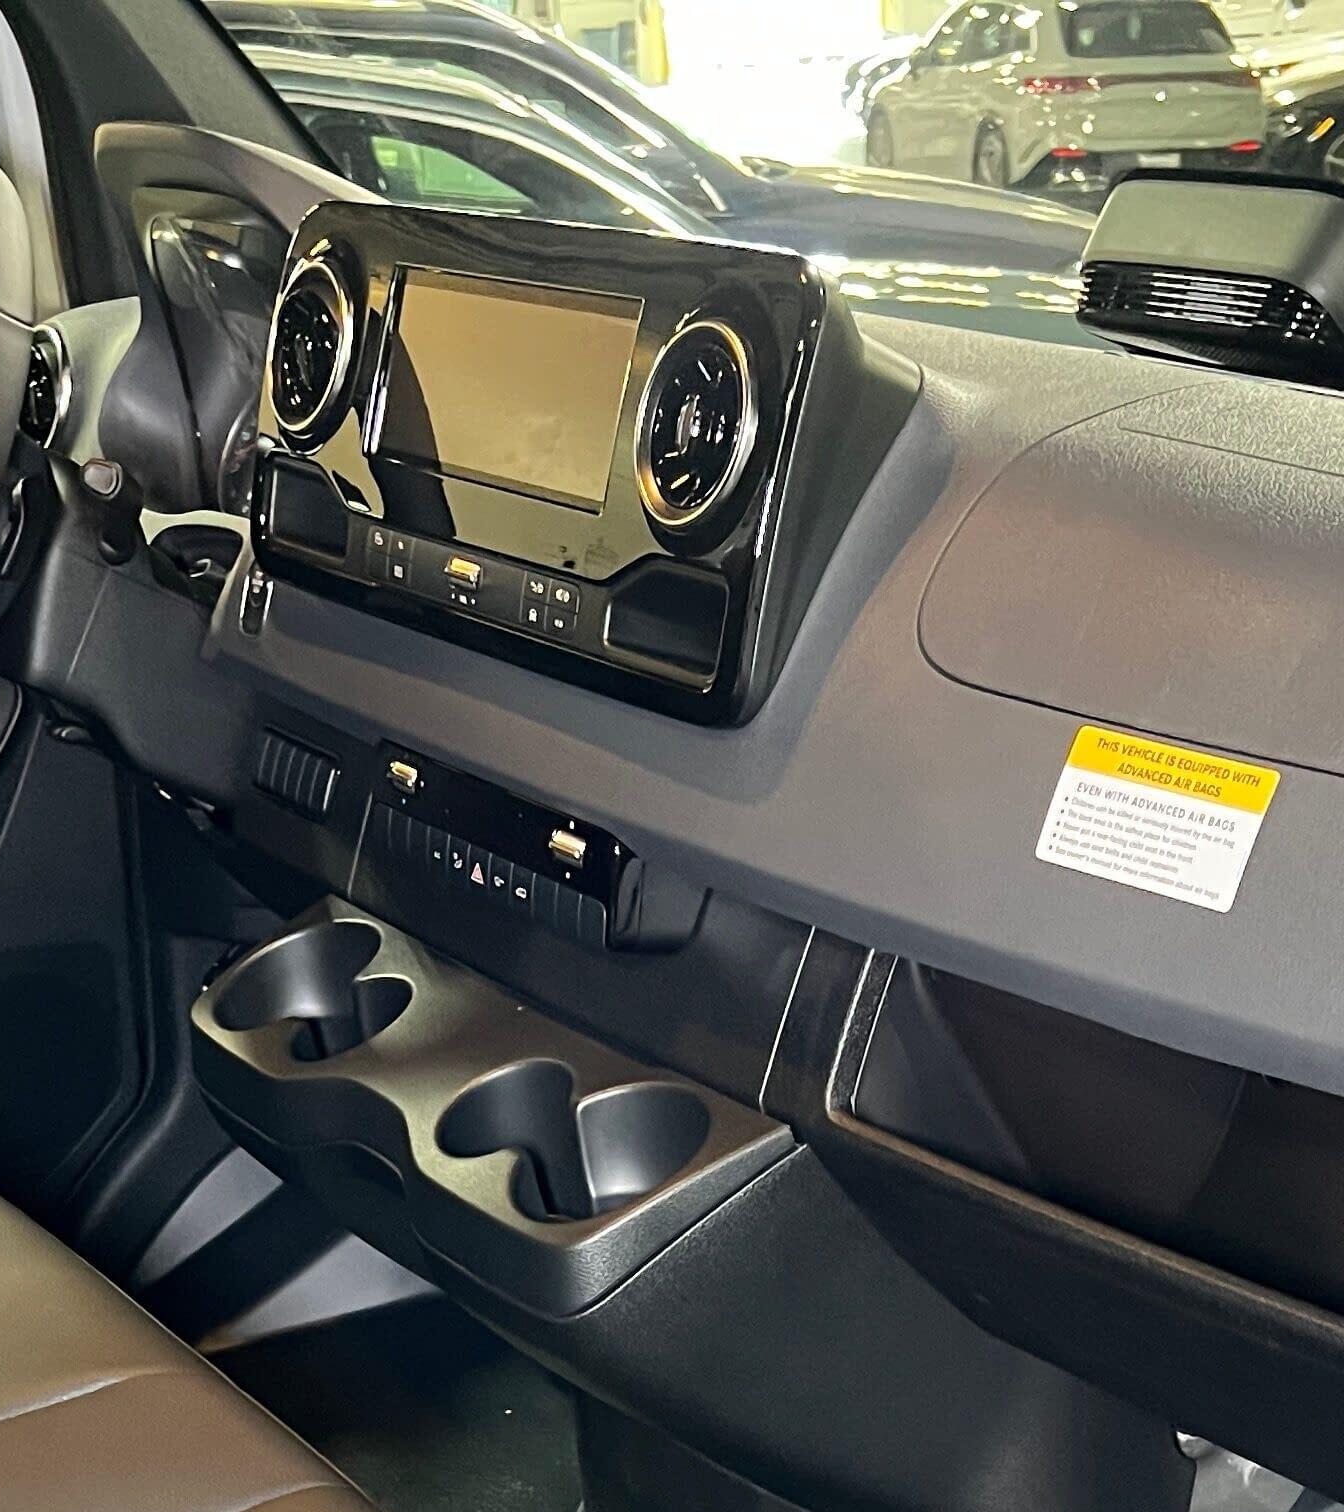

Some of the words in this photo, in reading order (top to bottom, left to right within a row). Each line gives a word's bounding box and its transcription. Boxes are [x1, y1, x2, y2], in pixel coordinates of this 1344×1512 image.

[1097, 737, 1119, 753] THIS
[1122, 745, 1164, 763] VEHICLE
[1165, 755, 1177, 767] IS
[1177, 758, 1231, 779] EQUIPPED
[1232, 771, 1261, 788] WITH
[1117, 762, 1173, 785] ADVANCED
[1173, 775, 1193, 791] AIR
[1193, 781, 1223, 798] BAGS
[1076, 781, 1102, 797] EVEN
[1104, 789, 1130, 804] WITH
[1131, 796, 1186, 819] ADVANCED
[1188, 811, 1206, 825] AIR
[1207, 816, 1235, 832] BAGS
